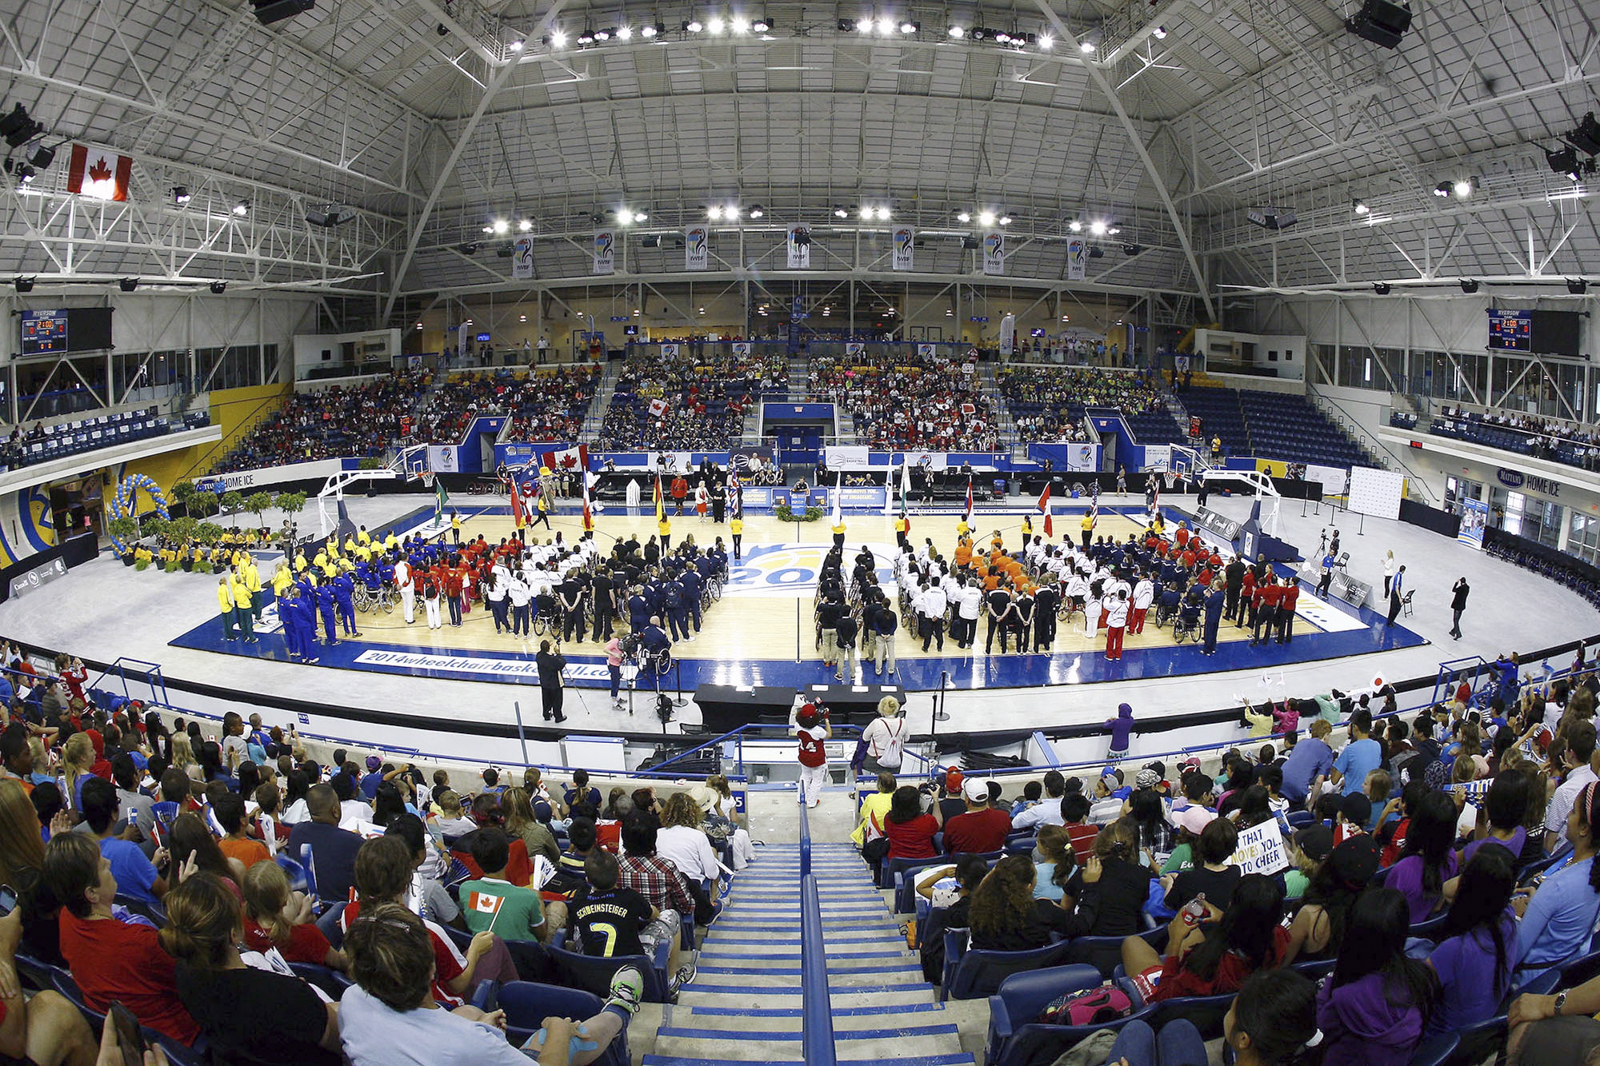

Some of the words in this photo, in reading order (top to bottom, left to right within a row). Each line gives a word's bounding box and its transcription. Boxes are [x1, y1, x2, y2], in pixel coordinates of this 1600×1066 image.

[243, 474, 254, 486] ICE
[1526, 475, 1548, 494] HOME
[1548, 480, 1561, 497] ICE
[1242, 828, 1263, 847] THAT
[1241, 860, 1253, 875] TO
[1255, 849, 1280, 869] CHEER
[576, 903, 628, 920] SCHWEINSTEIGER
[589, 922, 617, 958] 7
